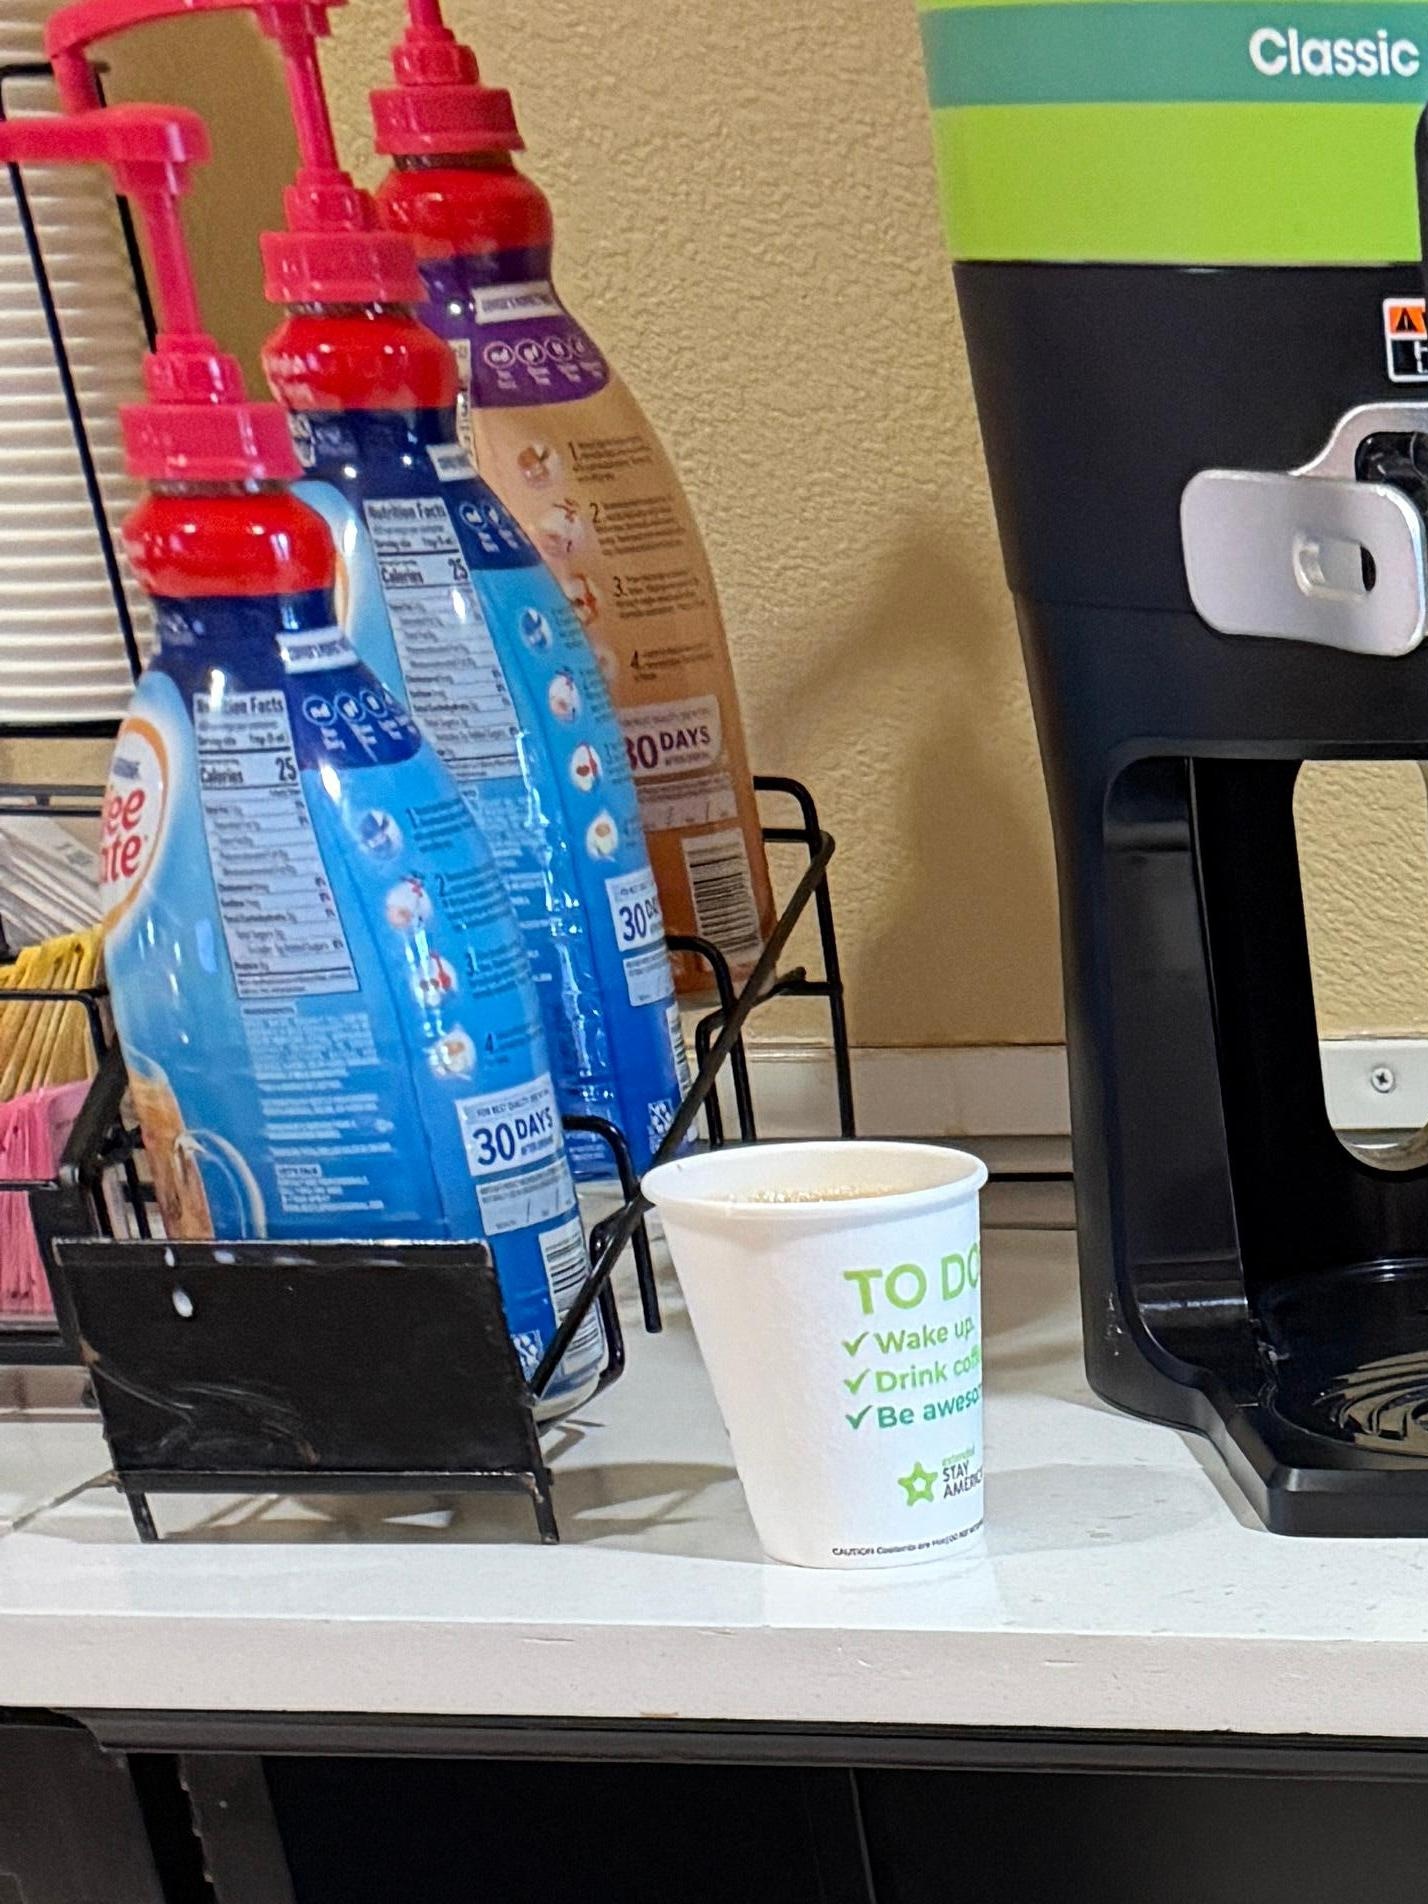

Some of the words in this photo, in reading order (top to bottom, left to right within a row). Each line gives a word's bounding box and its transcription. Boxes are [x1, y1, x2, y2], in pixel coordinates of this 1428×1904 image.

[1249, 28, 1420, 76] Classic
[448, 557, 468, 580] 25
[250, 696, 284, 713] Facts
[660, 725, 711, 751] DAYS
[200, 767, 243, 784] Calories
[275, 757, 297, 781] 25
[619, 903, 646, 941] 30
[473, 1123, 516, 1166] 30
[515, 1106, 554, 1140] DAYS
[843, 1263, 927, 1316] TO
[874, 1323, 949, 1354] Wake
[875, 1360, 948, 1392] Drink
[877, 1406, 914, 1428] Be
[923, 1384, 981, 1421] aweso
[942, 1460, 969, 1483] STAY
[943, 1465, 983, 1498] AMERIC
